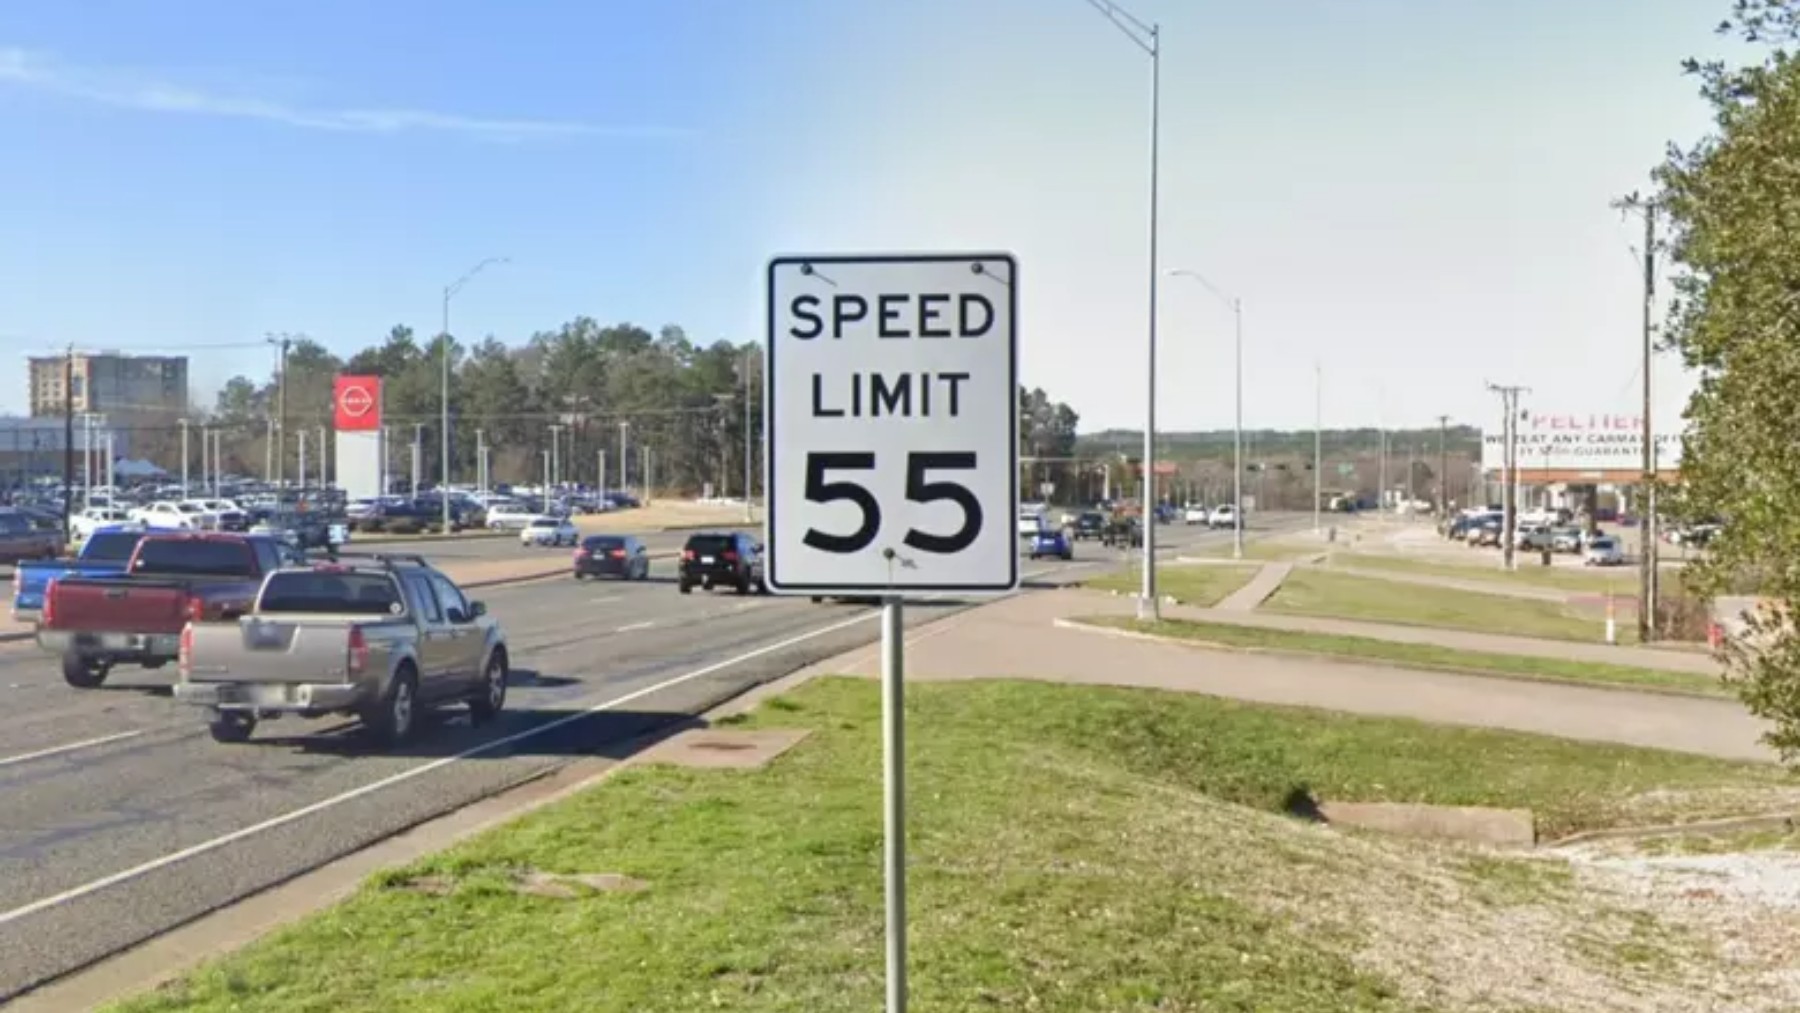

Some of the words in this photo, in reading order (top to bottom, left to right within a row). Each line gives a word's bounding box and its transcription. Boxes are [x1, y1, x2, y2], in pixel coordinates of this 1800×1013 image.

[791, 294, 994, 339] SPEED
[813, 373, 969, 416] LIMIT
[1553, 434, 1581, 444] ANY
[803, 451, 983, 554] 55
